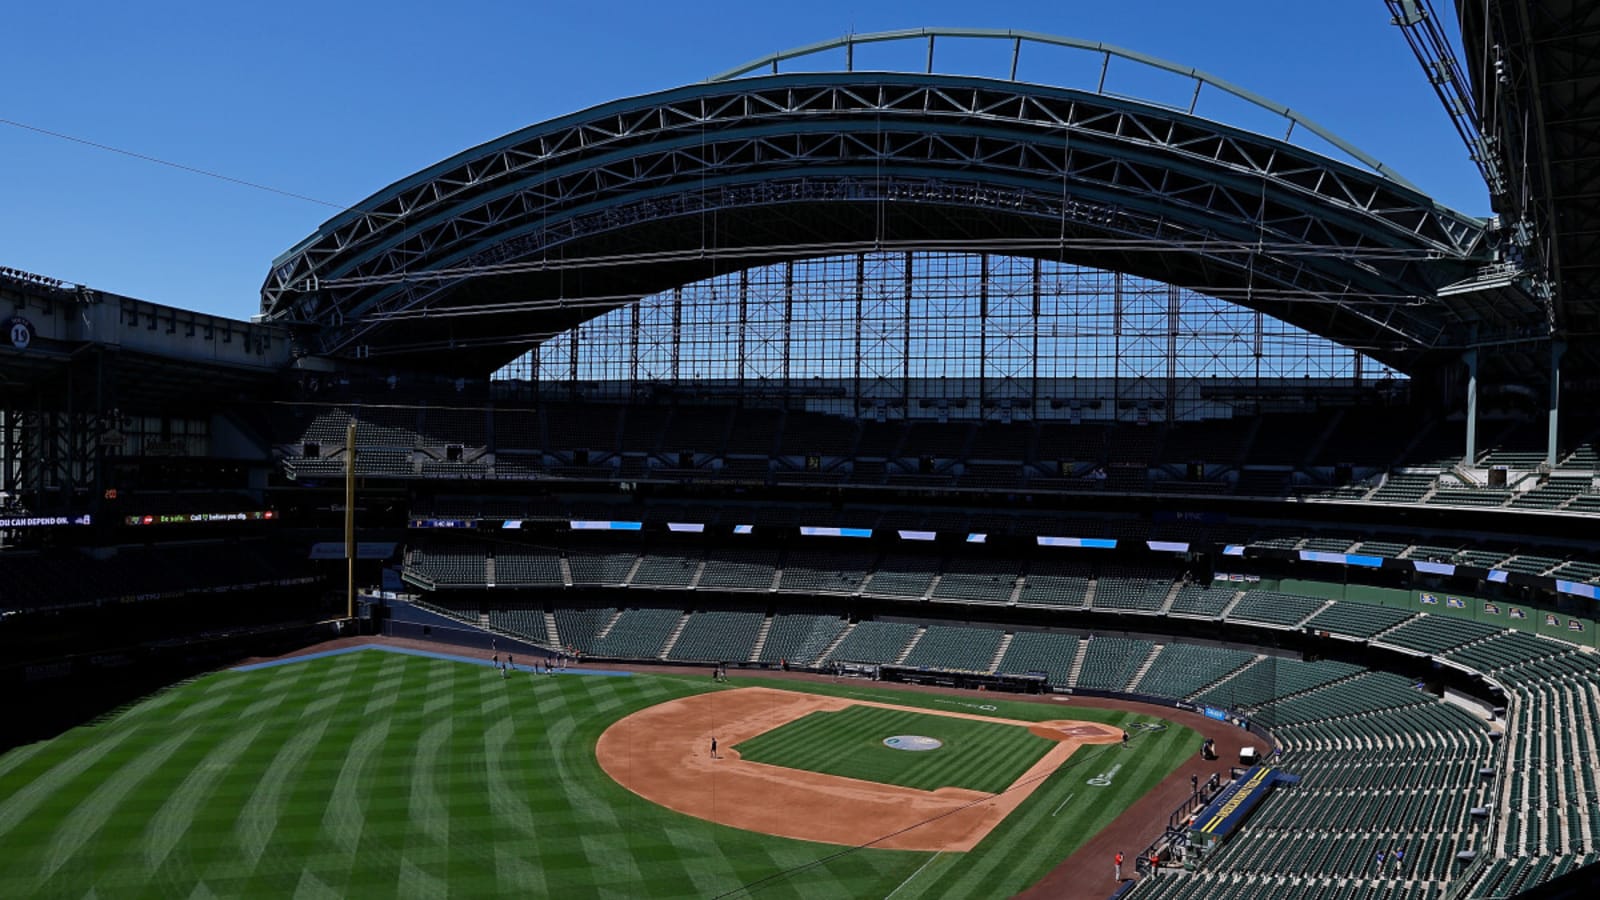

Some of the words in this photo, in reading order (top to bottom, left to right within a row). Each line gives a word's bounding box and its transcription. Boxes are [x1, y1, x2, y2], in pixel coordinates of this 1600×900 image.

[14, 329, 28, 342] 19
[11, 518, 26, 526] CAN
[27, 517, 56, 526] DEPEND
[209, 513, 227, 521] before
